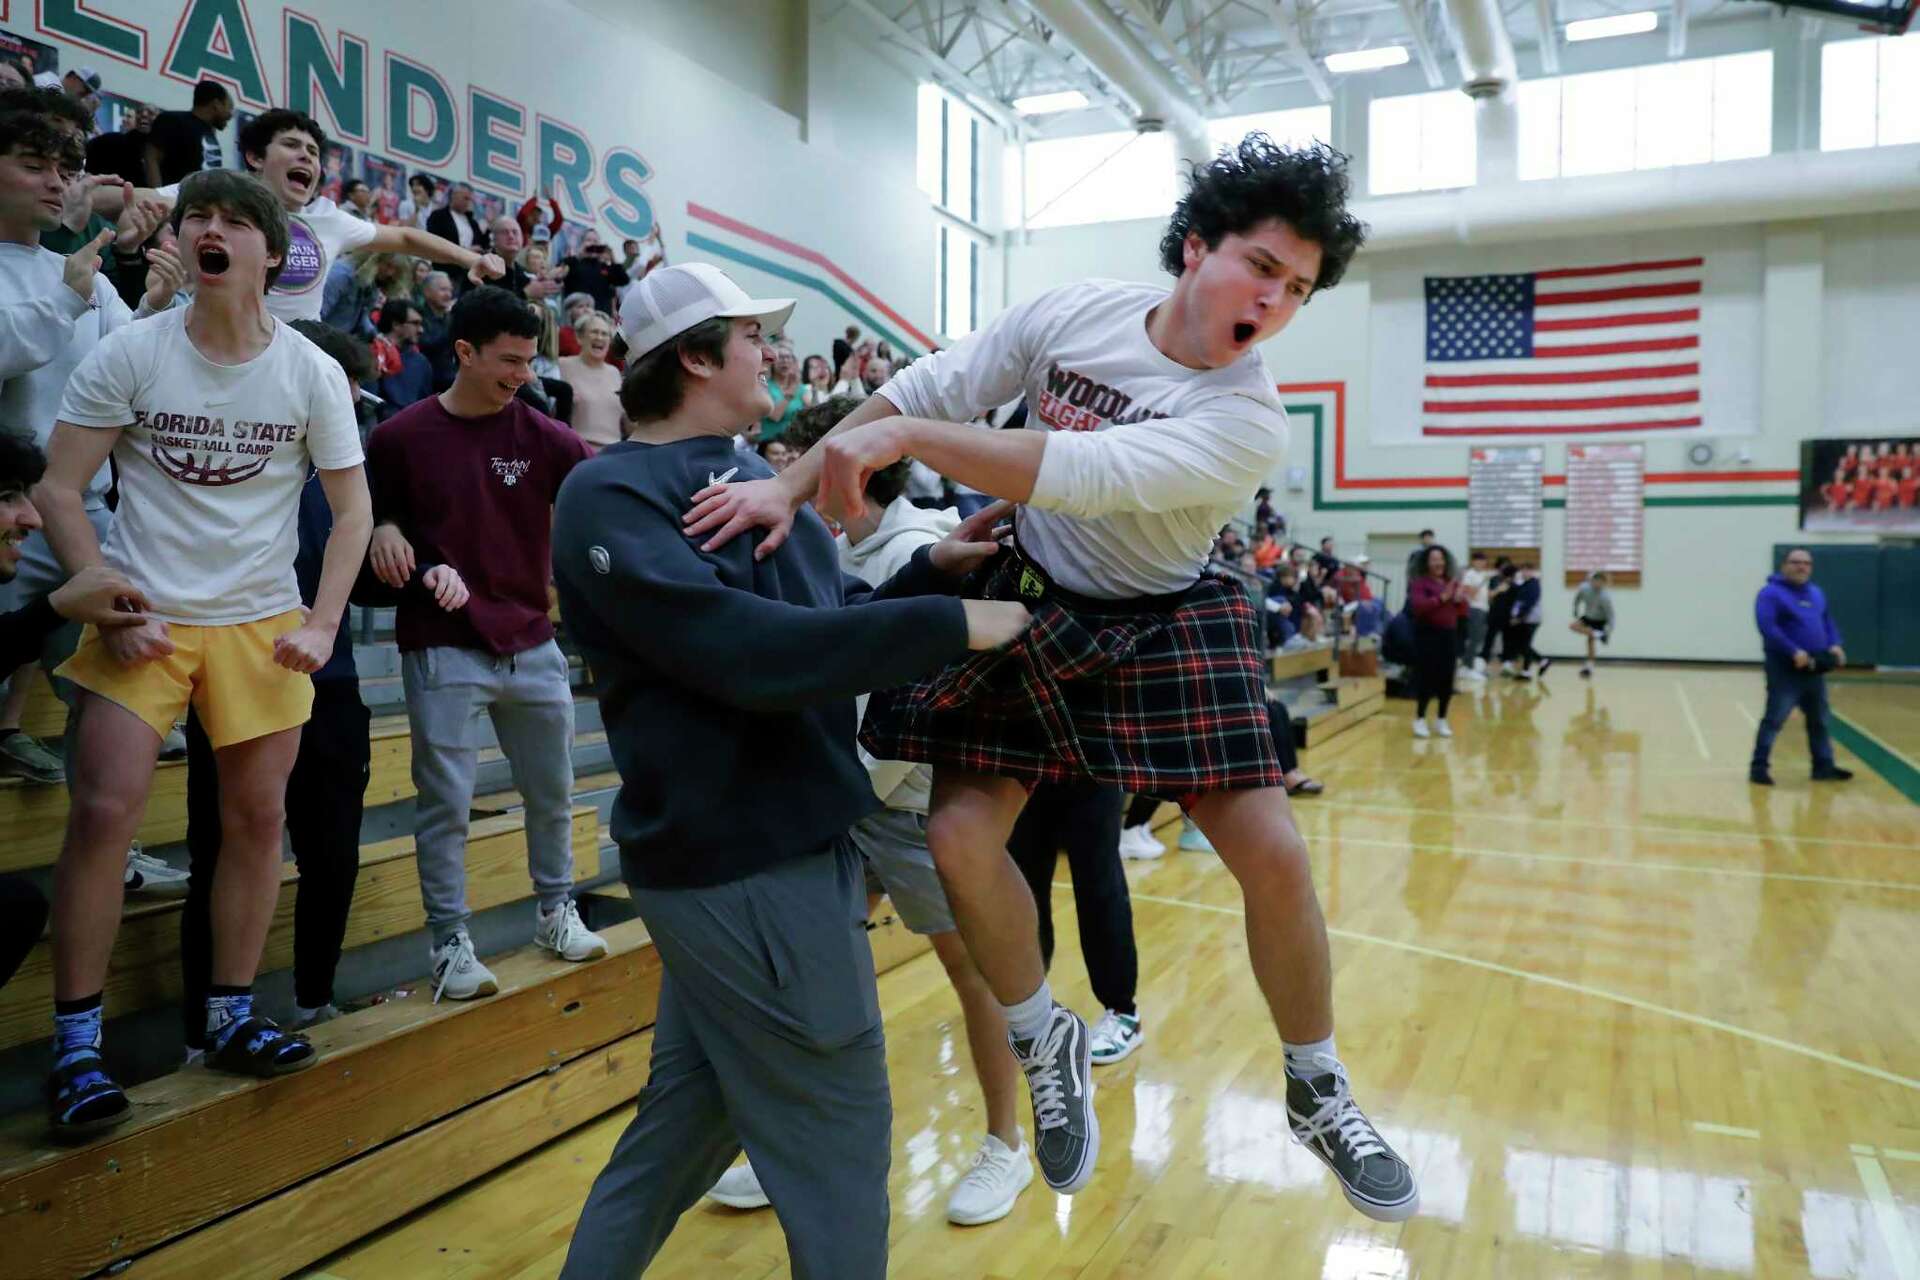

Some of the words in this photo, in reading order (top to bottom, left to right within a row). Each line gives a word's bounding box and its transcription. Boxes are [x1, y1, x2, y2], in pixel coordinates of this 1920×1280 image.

[134, 410, 225, 437] FLORIDA
[233, 420, 297, 442] STATE
[151, 433, 232, 453] BASKETBALL
[236, 442, 275, 455] CAMP
